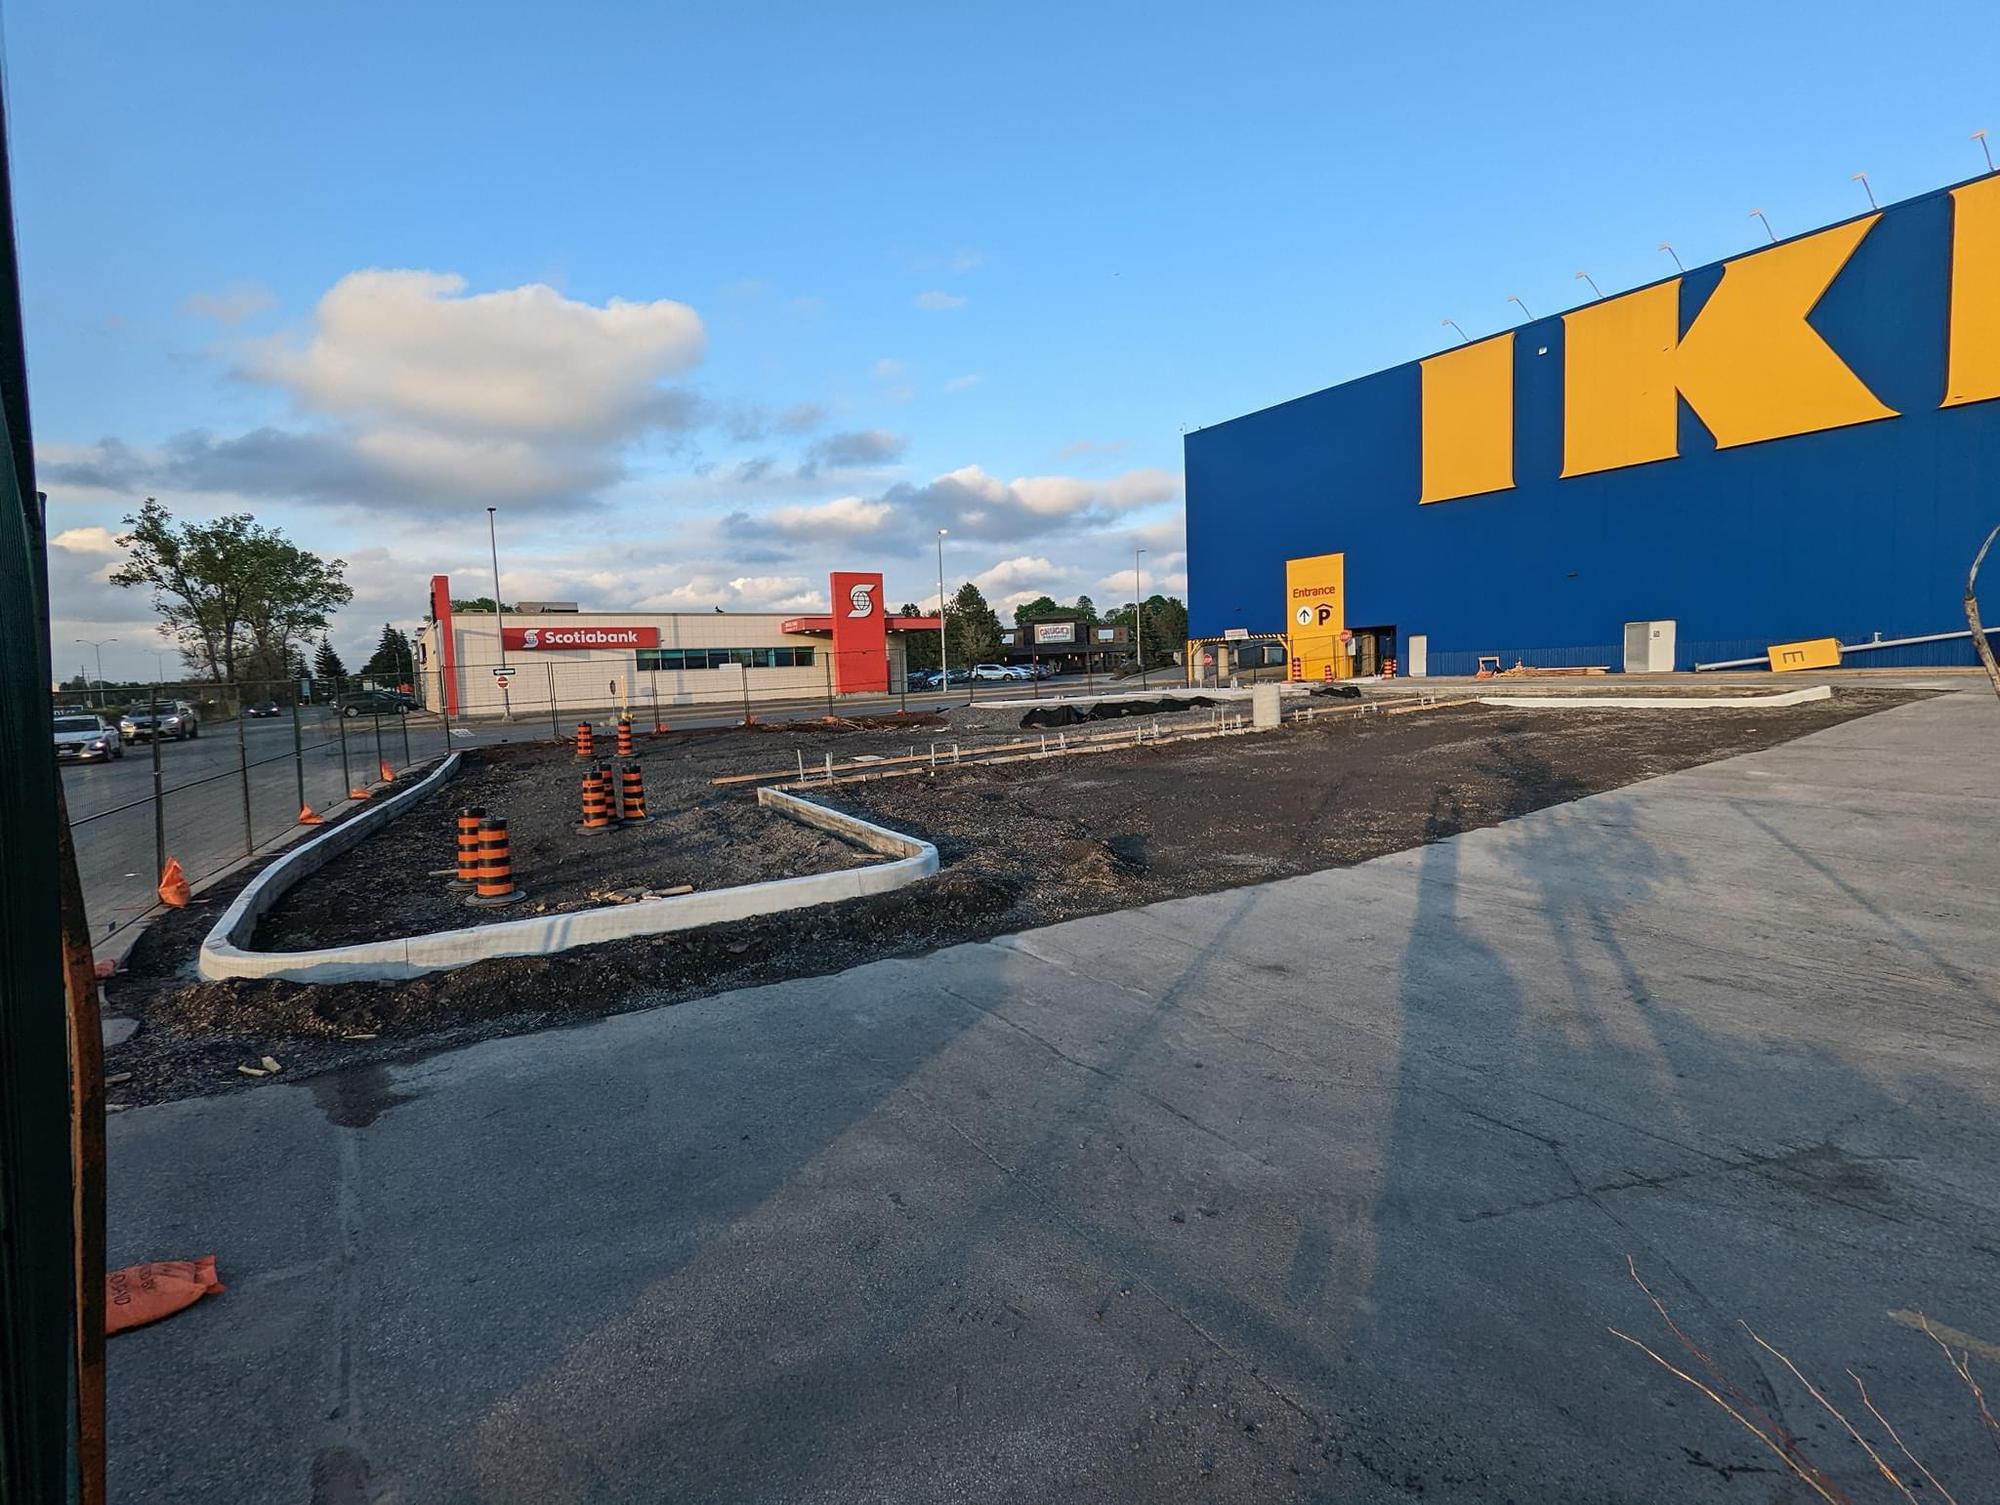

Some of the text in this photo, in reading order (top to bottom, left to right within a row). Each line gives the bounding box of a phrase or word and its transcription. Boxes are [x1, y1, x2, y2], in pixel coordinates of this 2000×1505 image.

[1419, 175, 2000, 505] IK
[1293, 586, 1336, 599] Entrance
[1318, 608, 1331, 626] P
[545, 630, 638, 644] Scotiabank
